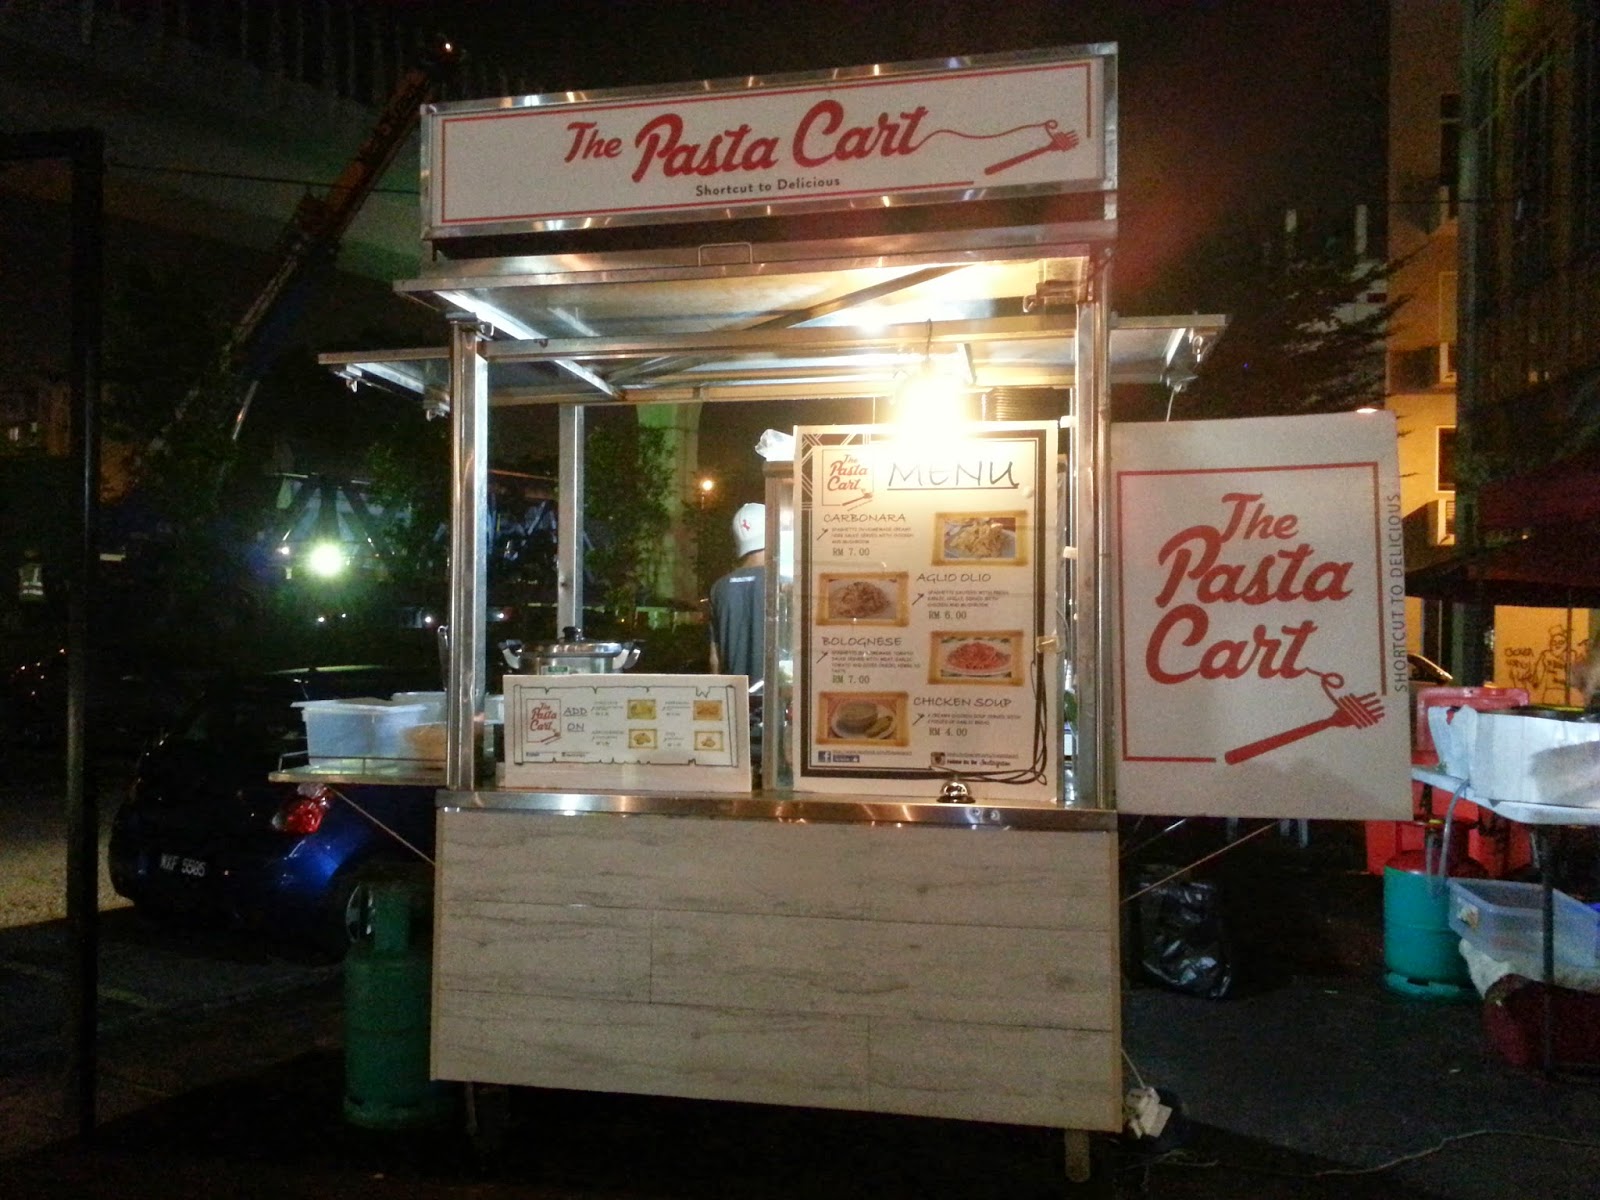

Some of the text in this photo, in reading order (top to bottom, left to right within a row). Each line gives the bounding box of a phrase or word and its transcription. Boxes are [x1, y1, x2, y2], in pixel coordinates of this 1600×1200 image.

[565, 100, 929, 183] The Pasta Cart
[696, 176, 841, 197] Shortcut to Delicious
[843, 454, 858, 464] The
[830, 460, 869, 476] Pasta
[887, 461, 1020, 488] MENU
[827, 475, 861, 491] Cart
[824, 513, 906, 523] CARBONARA
[1221, 492, 1299, 543] The
[832, 547, 844, 556] RM
[1155, 524, 1354, 608] Pasta
[916, 573, 992, 584] AGLIO OLIO
[1387, 494, 1407, 693] SHORTCUT TO DELICIOUS
[928, 610, 940, 620] RM
[822, 636, 902, 648] BOLOGNESE
[1146, 603, 1318, 684] Cart
[913, 697, 1012, 708] CHICKEN SOUP
[563, 707, 588, 716] ADD
[567, 722, 585, 731] ON
